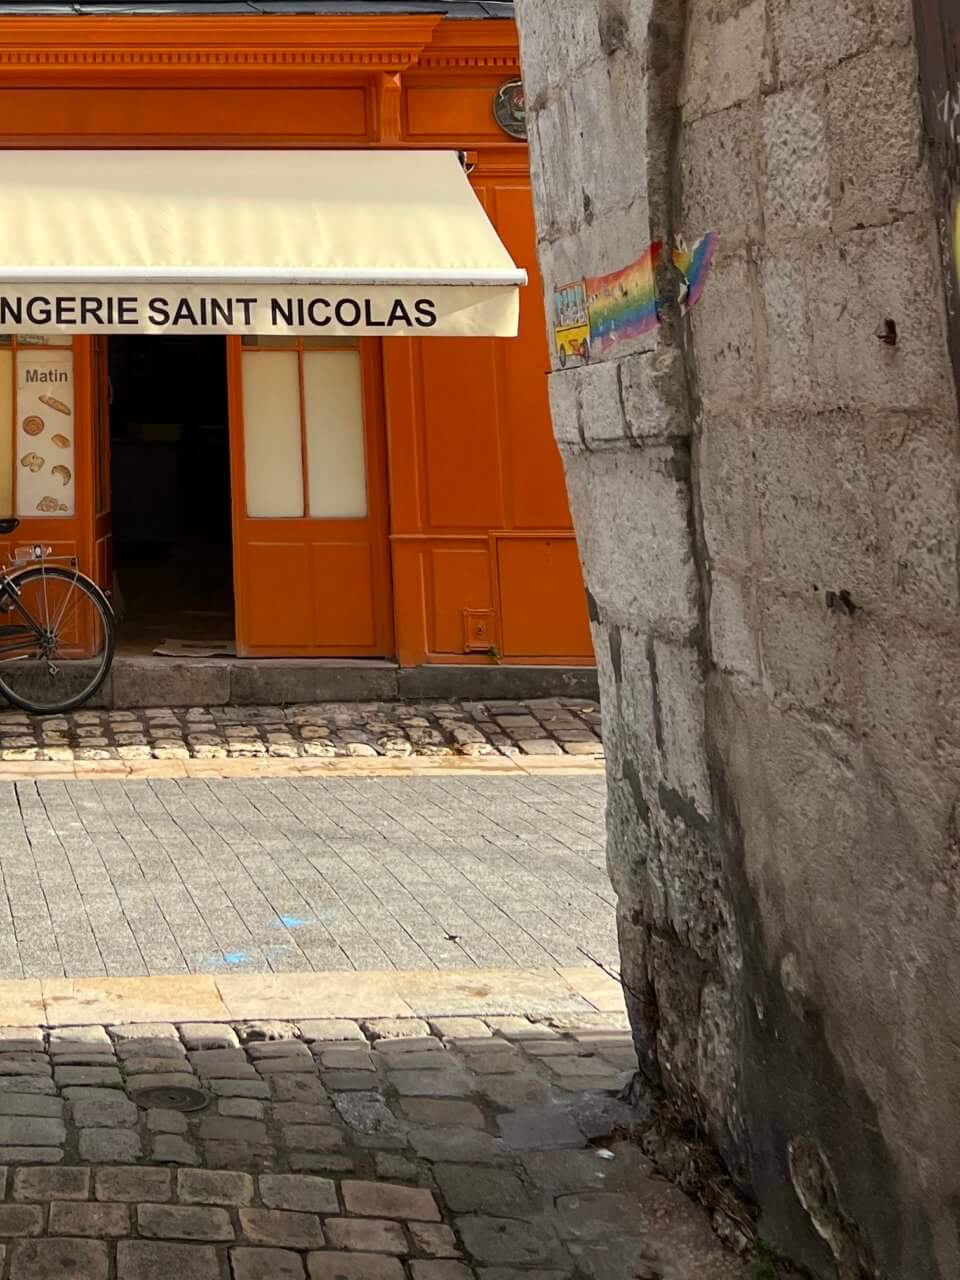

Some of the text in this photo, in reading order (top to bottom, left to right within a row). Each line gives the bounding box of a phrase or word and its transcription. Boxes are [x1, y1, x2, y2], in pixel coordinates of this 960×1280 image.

[148, 297, 257, 326] SAINT
[270, 297, 437, 327] NICOLAS
[25, 369, 68, 383] Matin
